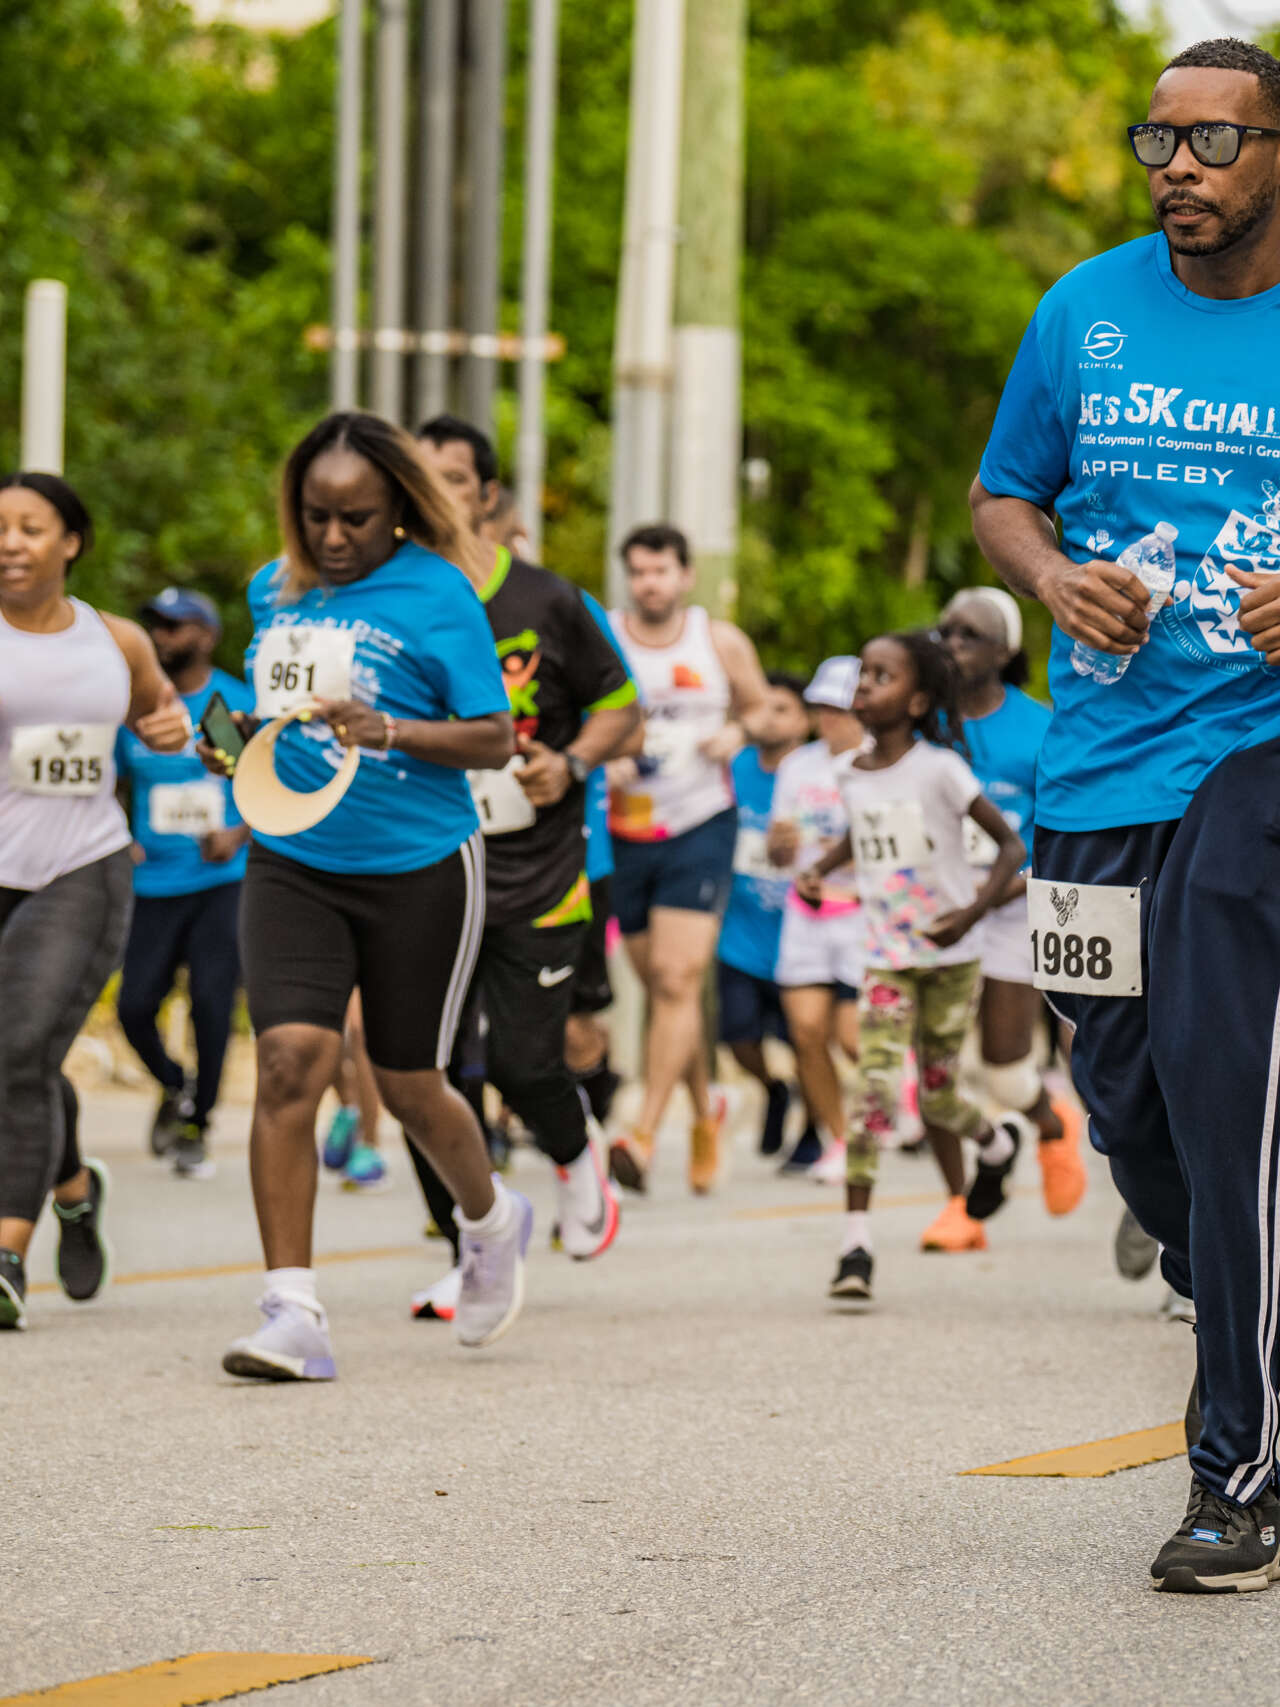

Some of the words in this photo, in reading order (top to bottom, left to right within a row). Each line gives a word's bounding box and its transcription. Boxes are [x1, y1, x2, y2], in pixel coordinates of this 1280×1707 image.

[1124, 382, 1184, 427] 5K
[1098, 432, 1145, 447] Cayman
[1156, 436, 1212, 451] Cayman
[1215, 441, 1245, 454] Brac
[1082, 460, 1234, 486] APPLEBY
[269, 661, 316, 692] 961
[29, 754, 103, 784] 1935
[1031, 929, 1113, 980] 1988
